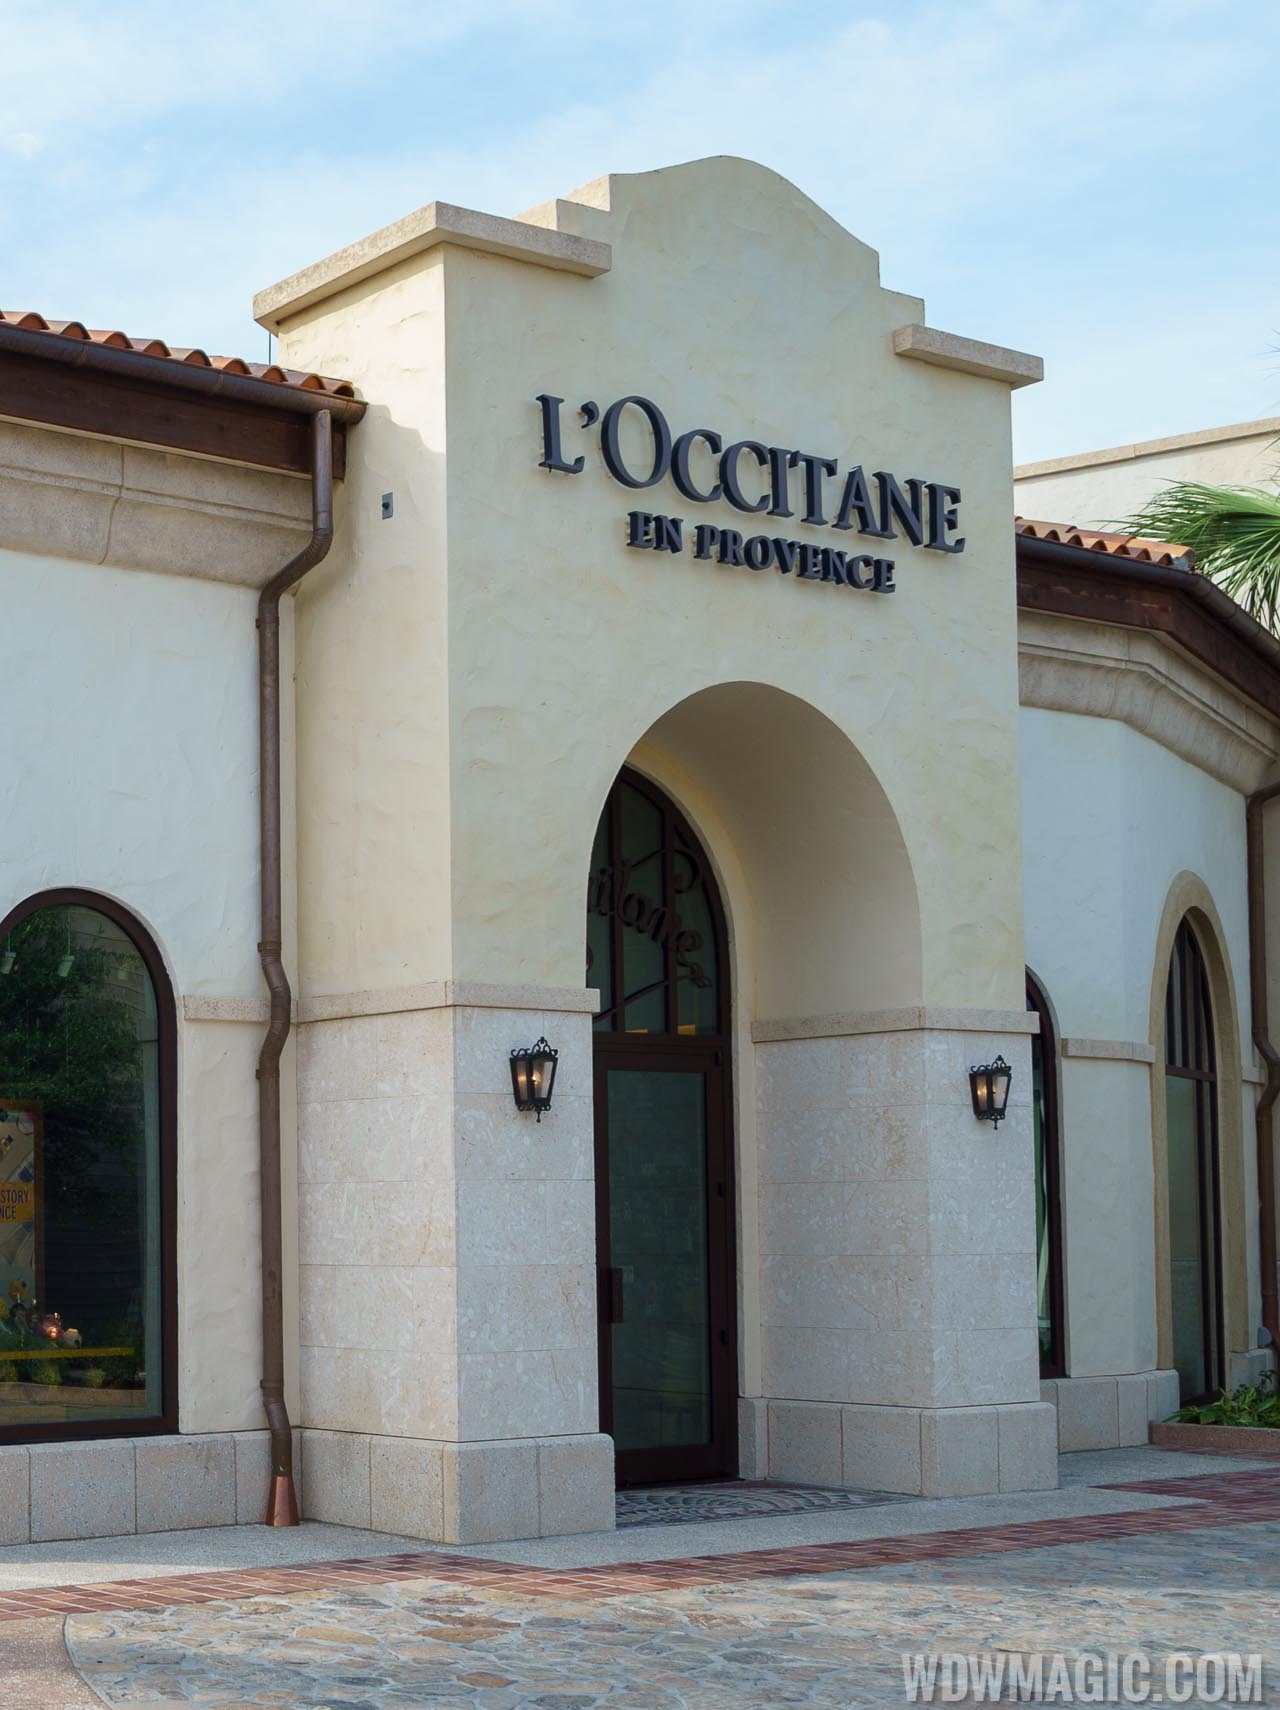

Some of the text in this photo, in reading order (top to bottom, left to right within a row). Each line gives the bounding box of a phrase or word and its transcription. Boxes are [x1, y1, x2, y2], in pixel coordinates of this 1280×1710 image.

[535, 393, 966, 554] L'OCCITANE
[626, 510, 896, 594] EN PROVENCE
[0, 1189, 30, 1204] STORY
